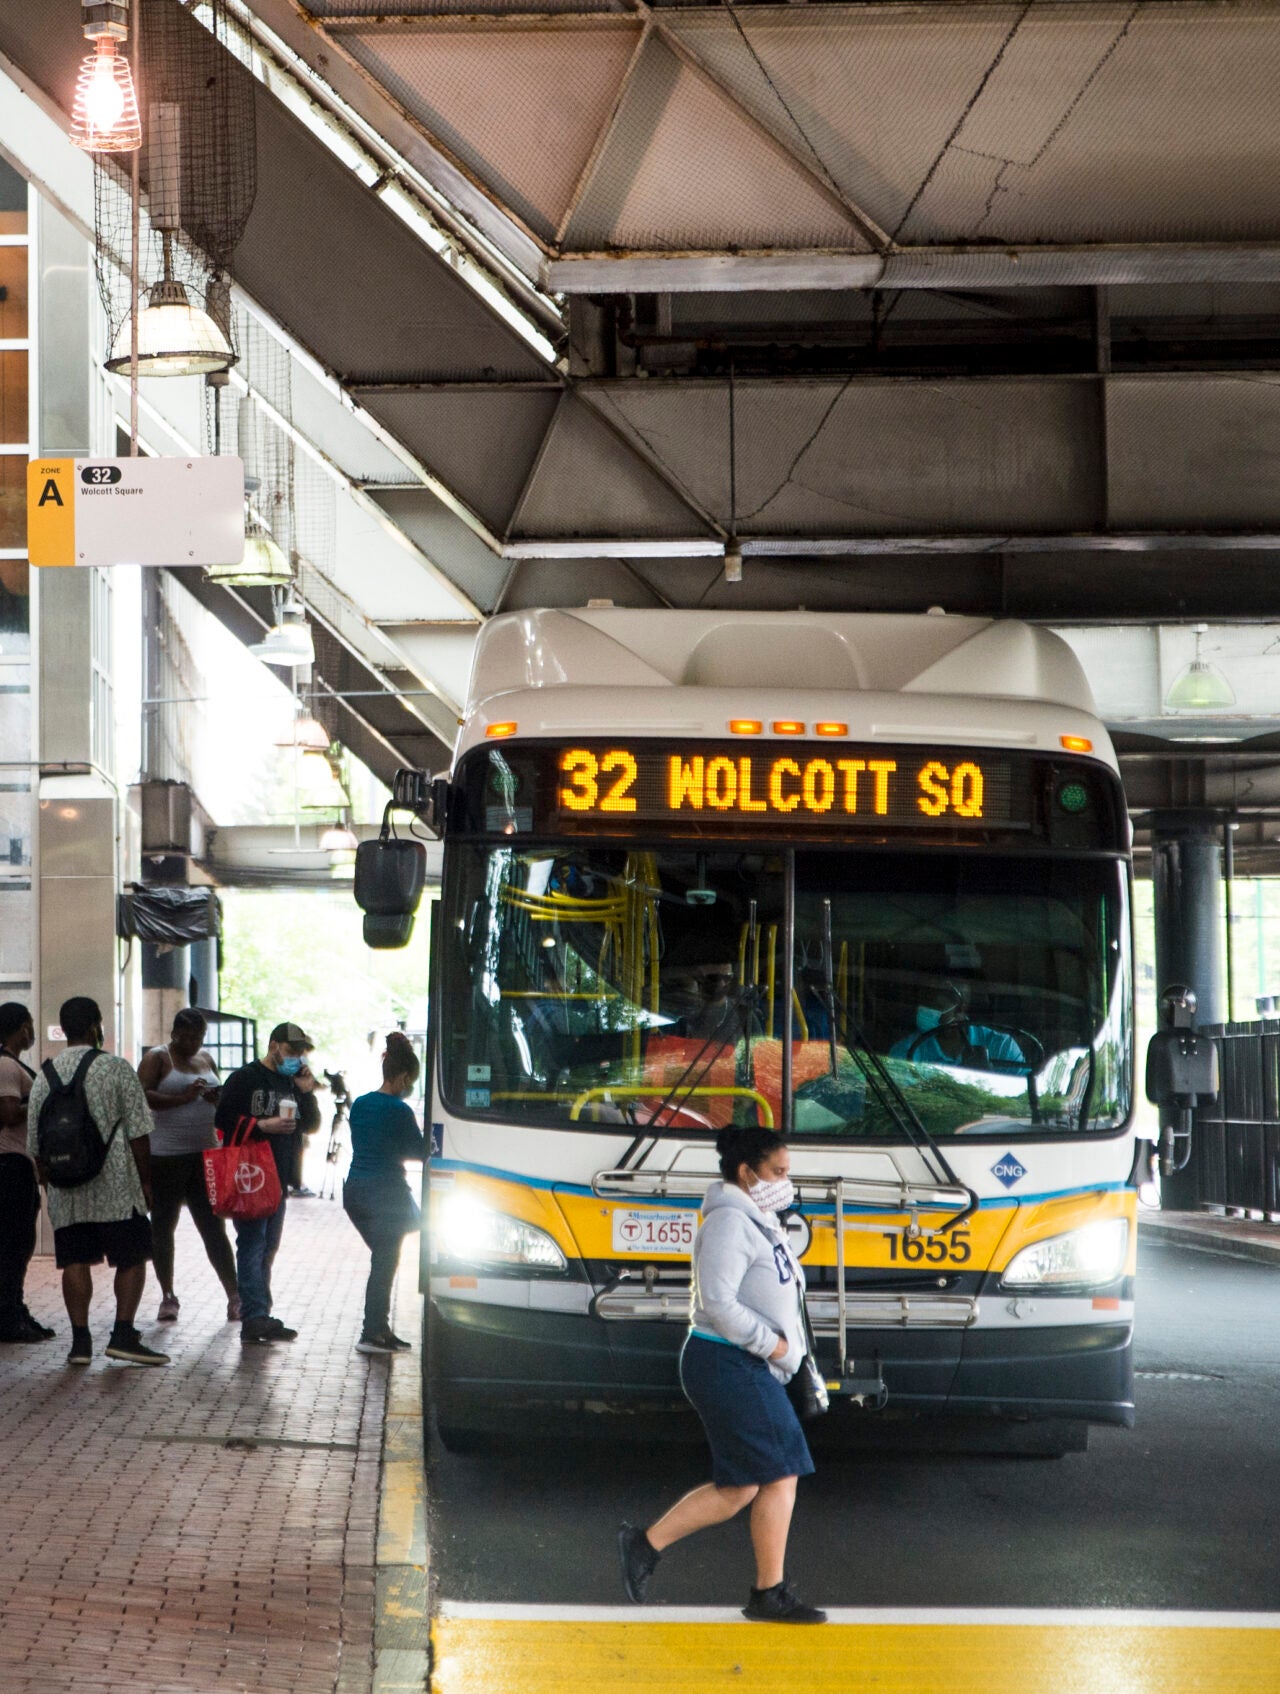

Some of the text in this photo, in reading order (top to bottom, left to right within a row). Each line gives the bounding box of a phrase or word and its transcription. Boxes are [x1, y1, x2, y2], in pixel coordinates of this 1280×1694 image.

[91, 467, 112, 483] 32
[38, 479, 64, 507] A
[81, 487, 143, 496] Wolcott Square
[561, 750, 984, 818] 32 WOLCOTT SQ
[993, 1164, 1024, 1177] CNG
[646, 1221, 693, 1244] 1655
[882, 1230, 972, 1264] 1655
